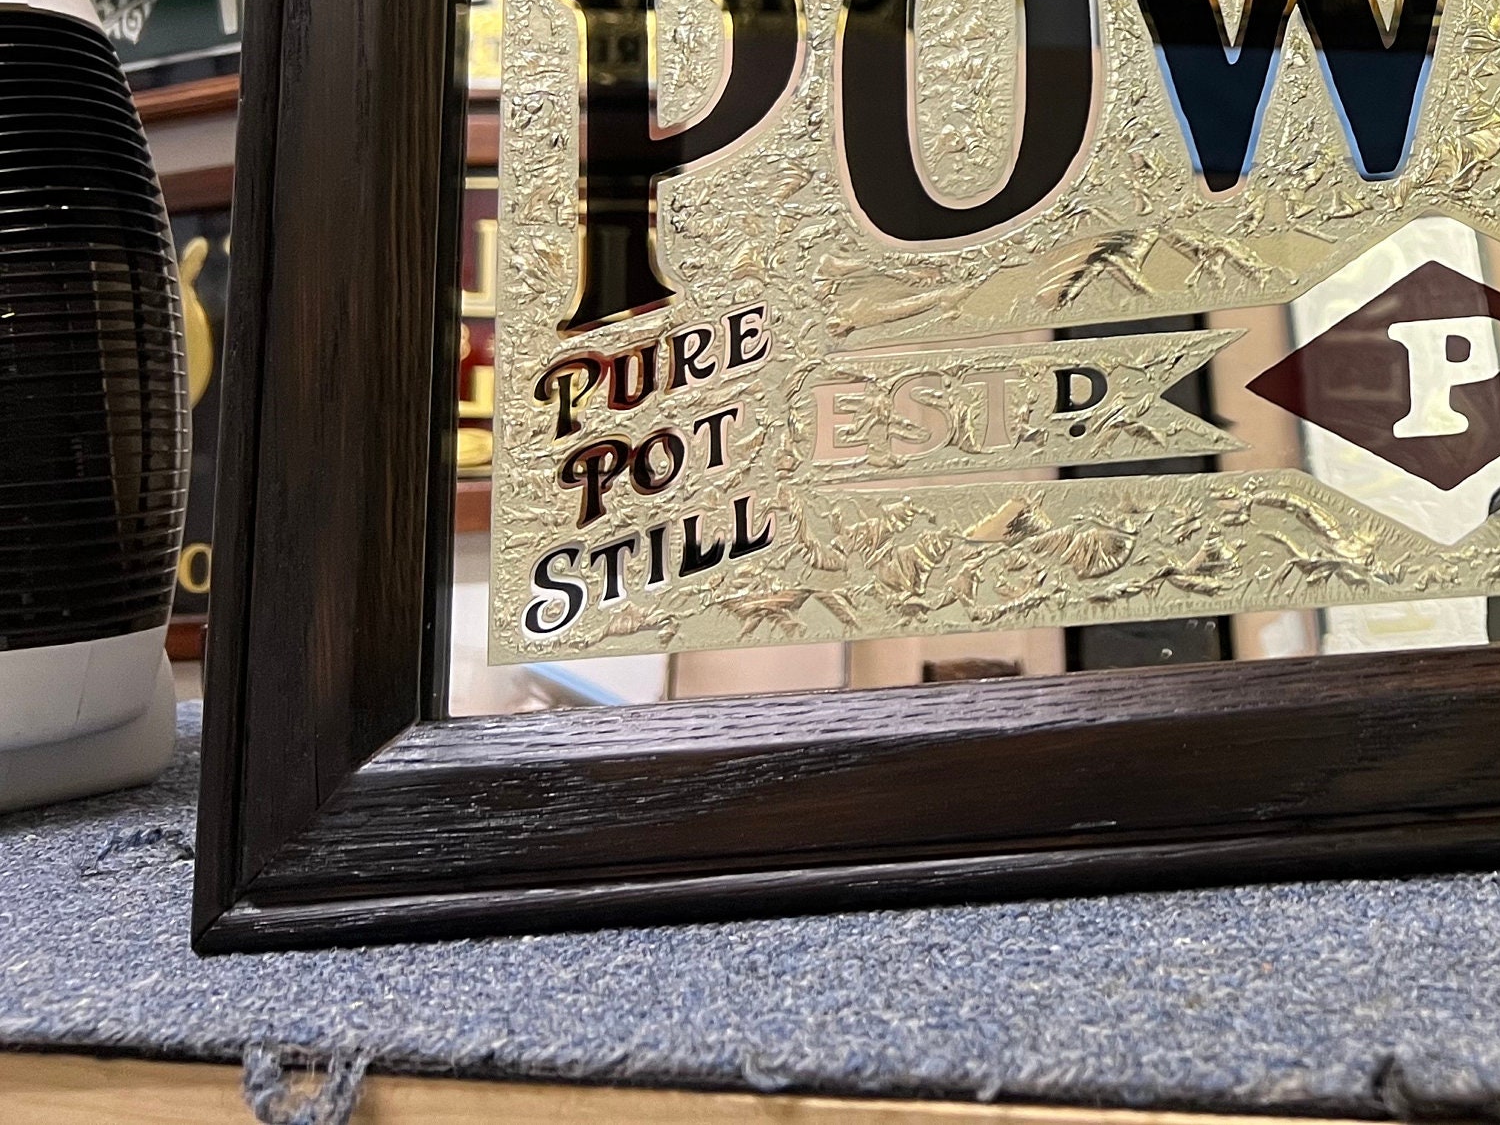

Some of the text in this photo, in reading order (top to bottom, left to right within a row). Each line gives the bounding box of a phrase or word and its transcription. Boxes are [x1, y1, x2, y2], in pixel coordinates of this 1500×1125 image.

[532, 301, 774, 441] PURE
[557, 402, 745, 530] POT
[520, 492, 778, 641] STILL
